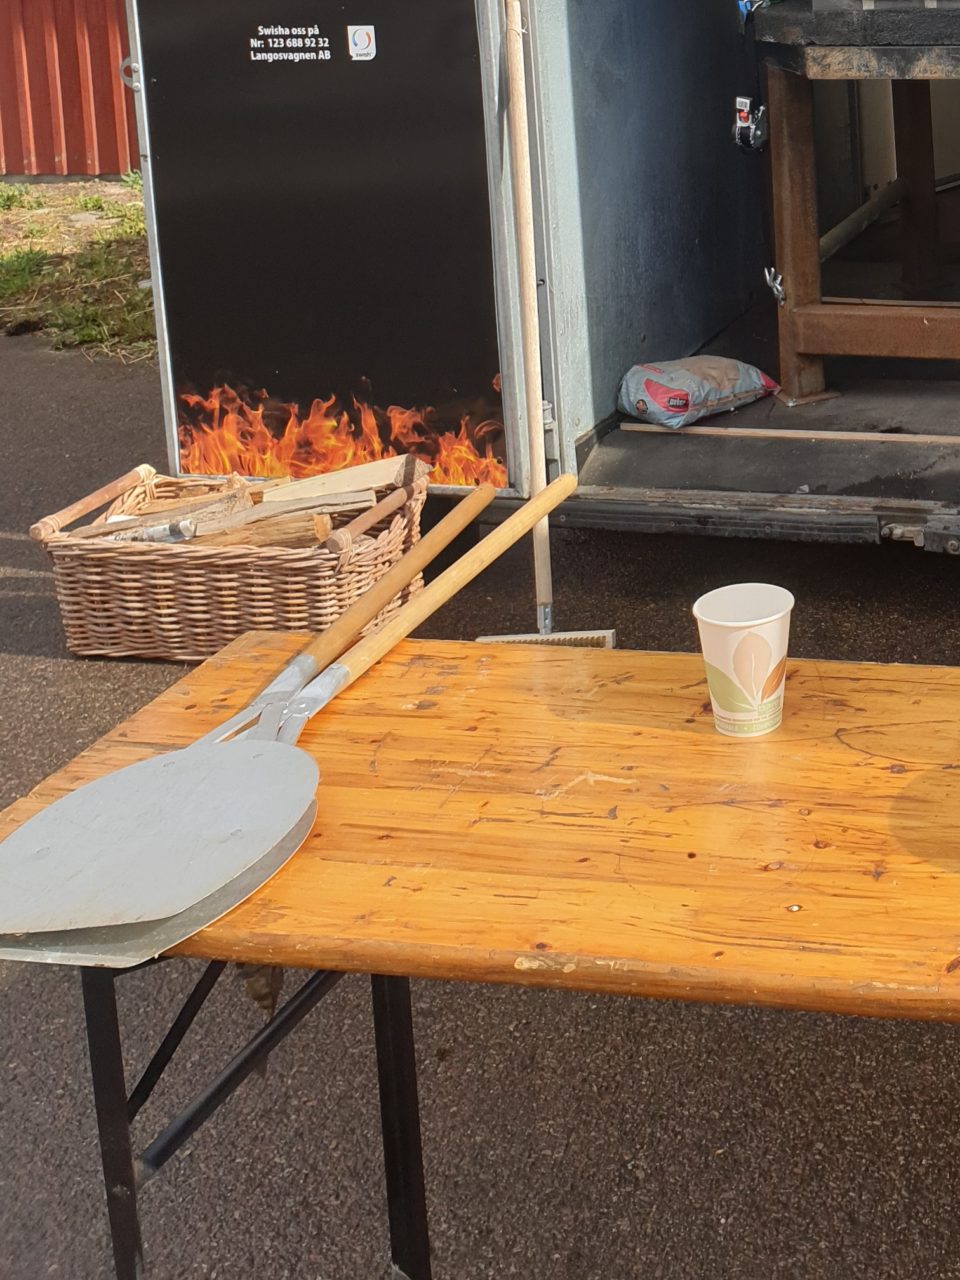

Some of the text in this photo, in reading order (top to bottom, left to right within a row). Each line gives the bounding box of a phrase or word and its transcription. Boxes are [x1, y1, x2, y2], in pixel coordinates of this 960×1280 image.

[258, 25, 290, 36] Swisha
[308, 25, 319, 37] på
[250, 38, 329, 48] Nr: 123 688 92 32
[251, 50, 331, 62] Langosvagnen AB
